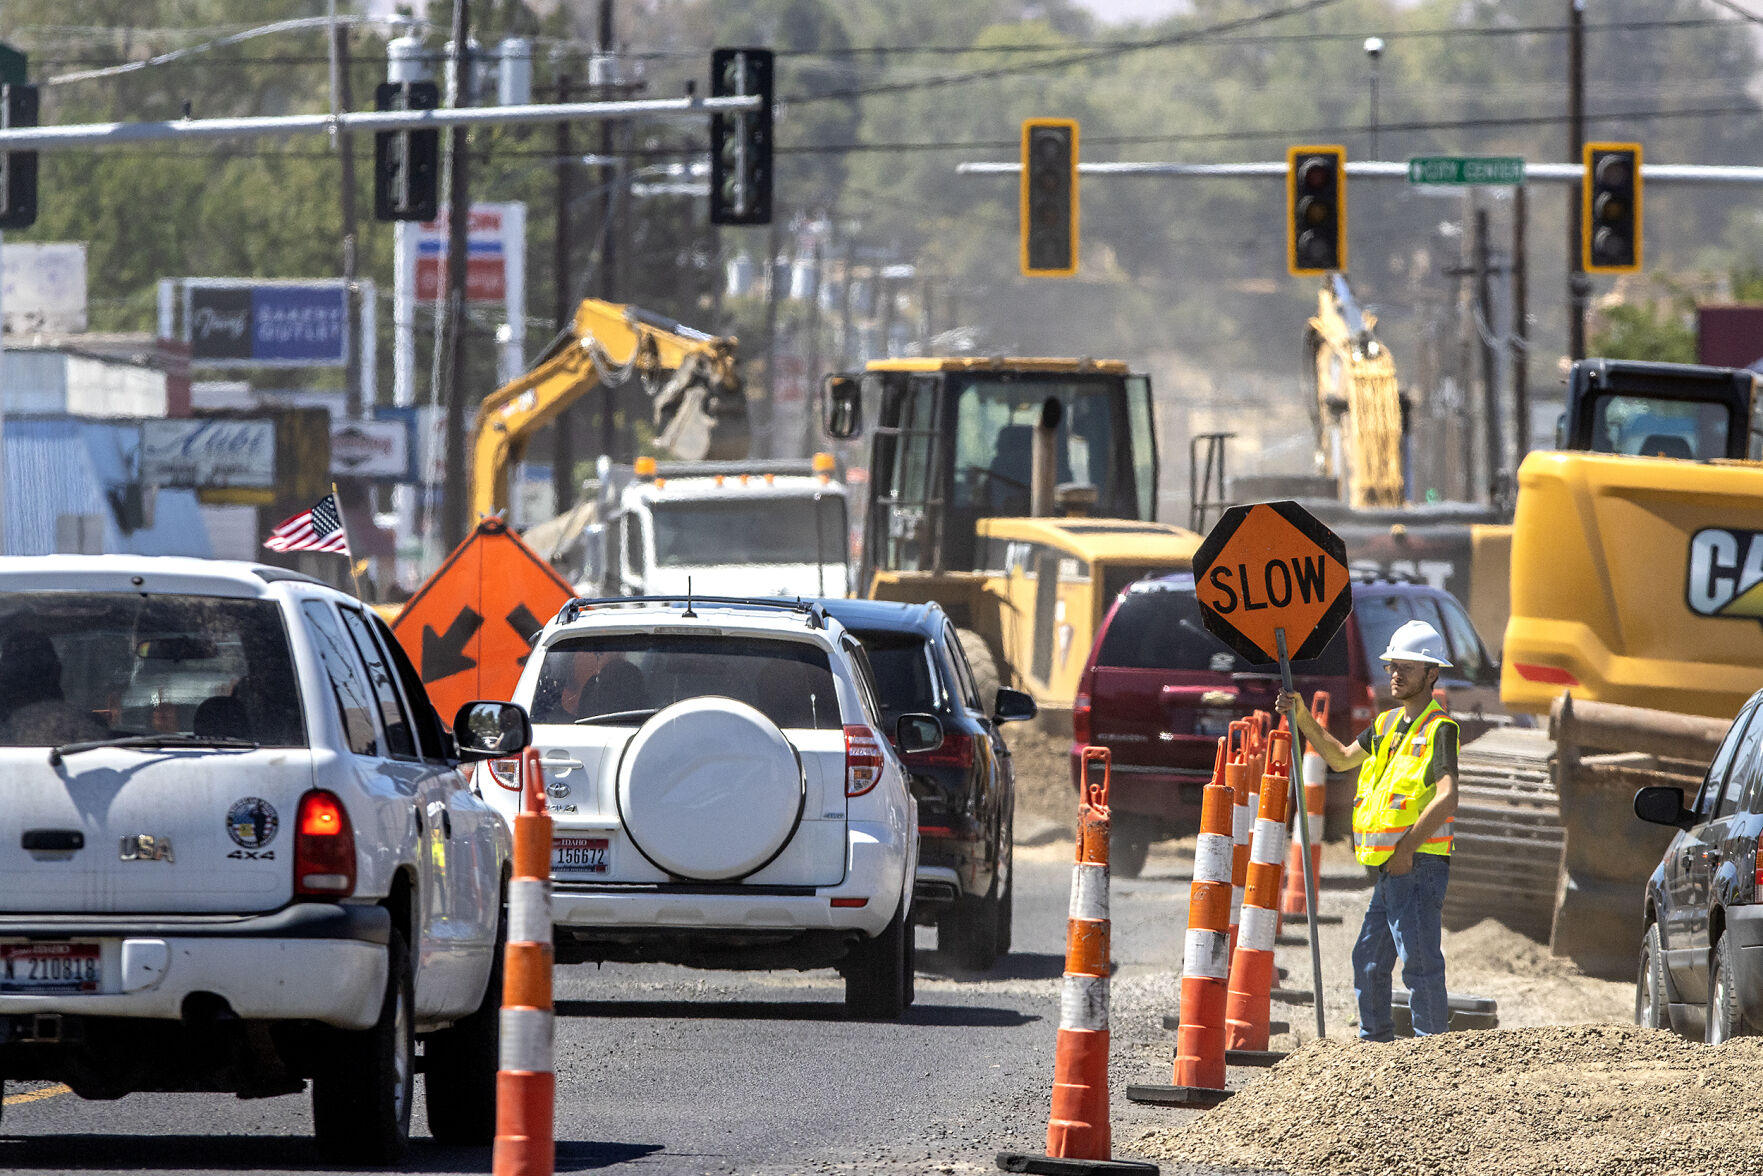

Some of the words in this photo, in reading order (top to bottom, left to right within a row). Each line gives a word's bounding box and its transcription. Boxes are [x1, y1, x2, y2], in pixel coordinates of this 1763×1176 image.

[1210, 554, 1326, 615] SLOW
[119, 834, 175, 863] USA
[561, 839, 588, 847] IDAHO
[558, 848, 605, 865] 156672
[28, 957, 96, 980] 210818
